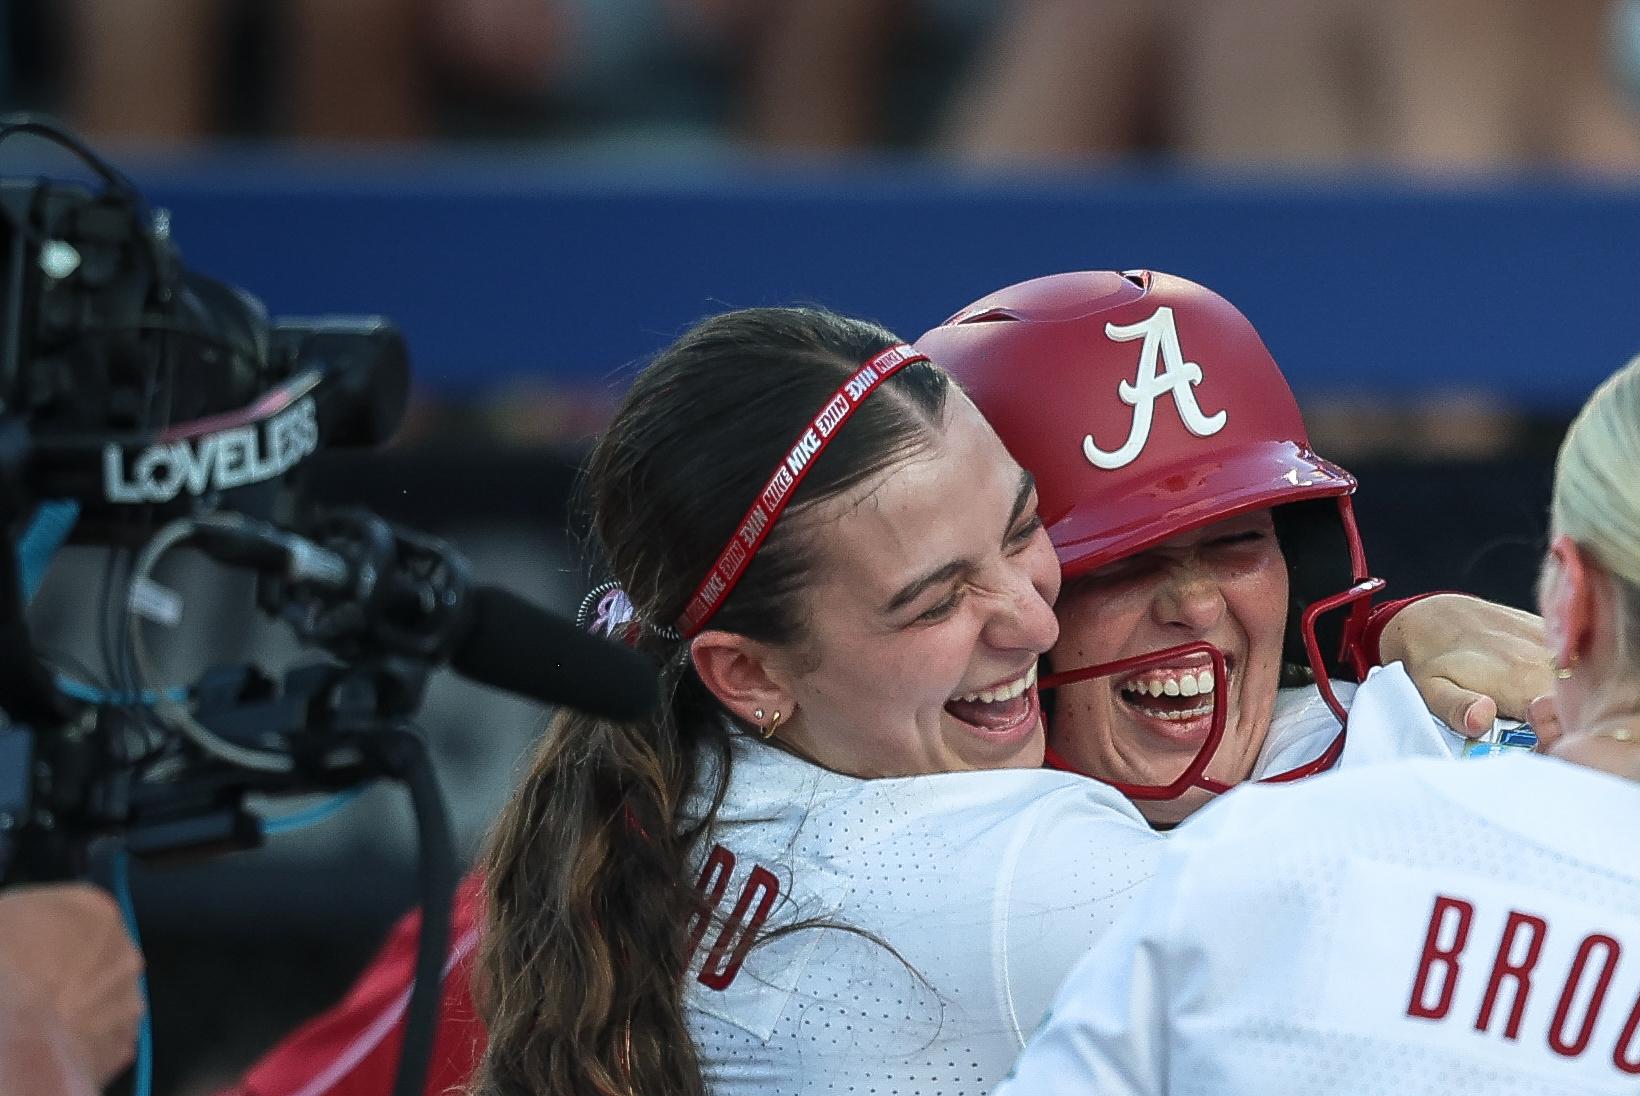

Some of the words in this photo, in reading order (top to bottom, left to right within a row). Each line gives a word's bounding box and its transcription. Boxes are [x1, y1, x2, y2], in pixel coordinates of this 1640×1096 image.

[1083, 306, 1227, 470] A
[763, 465, 794, 512] NIKE
[787, 428, 823, 477] NIKE
